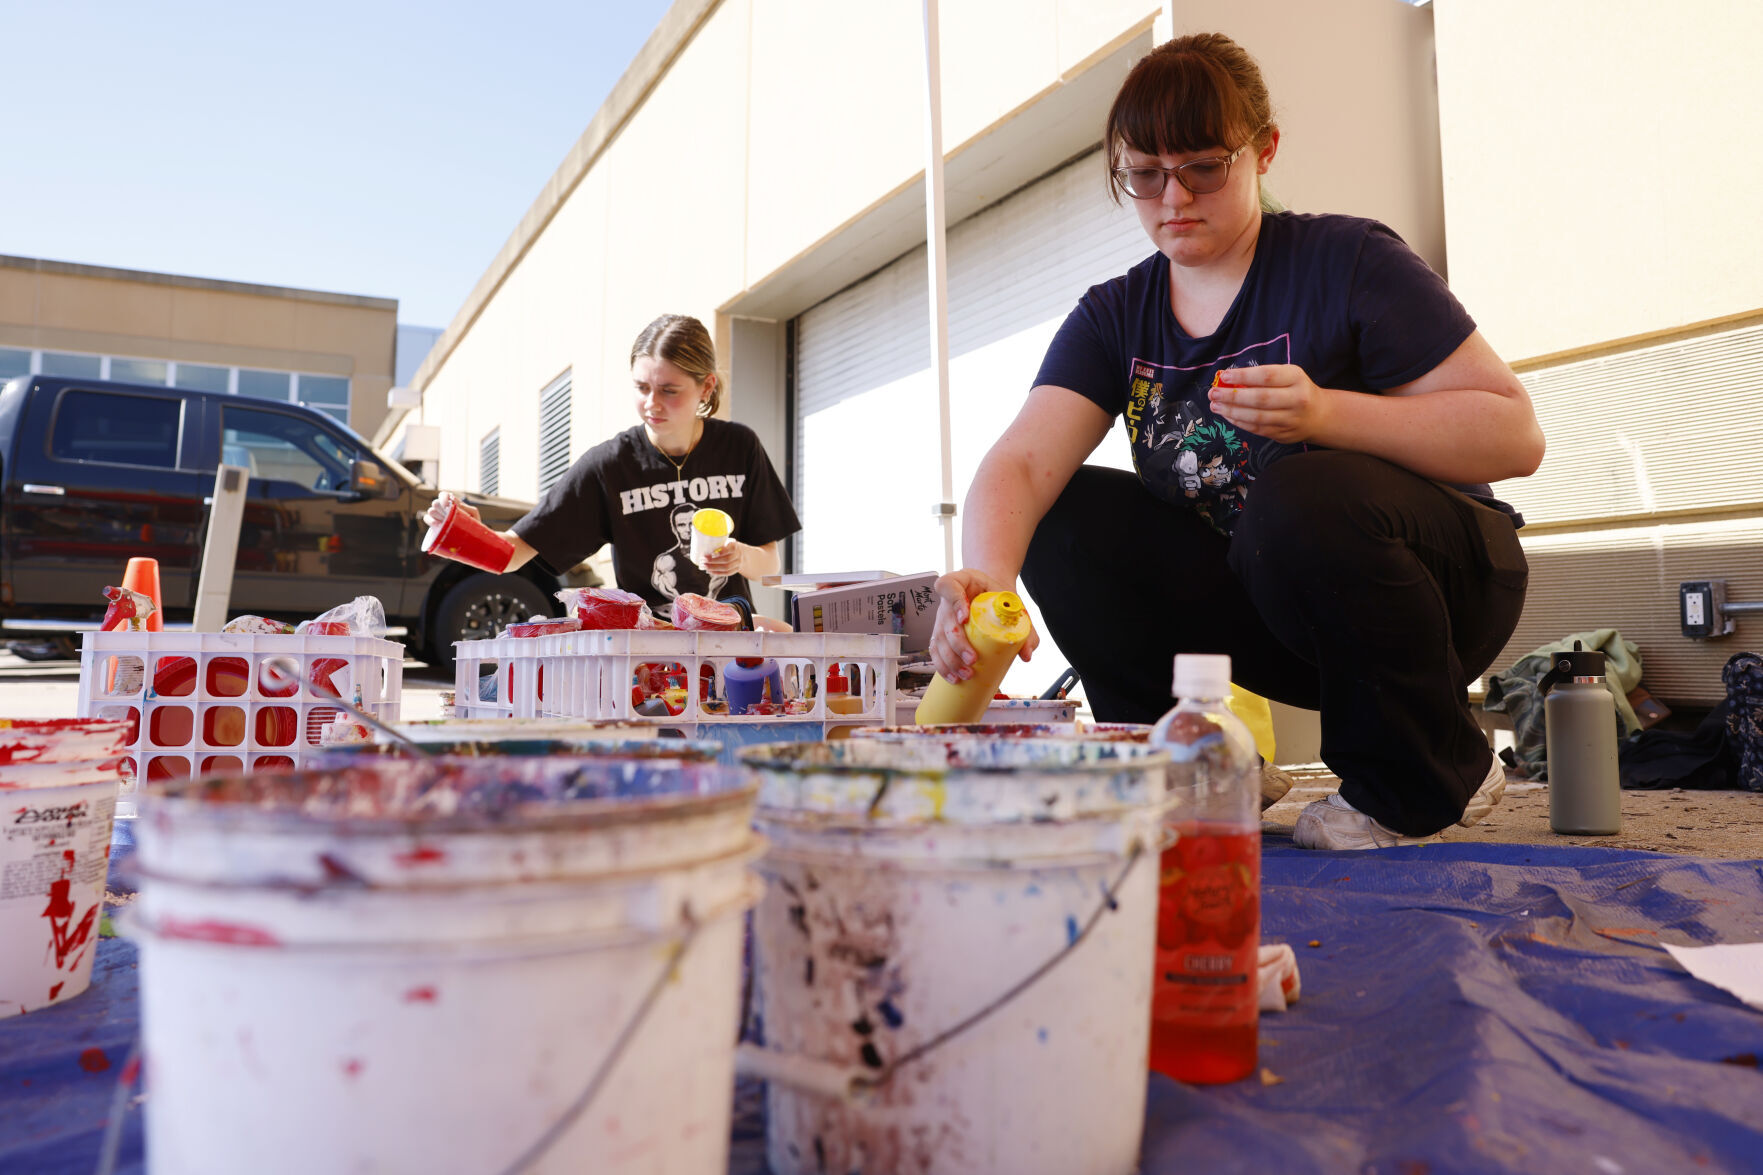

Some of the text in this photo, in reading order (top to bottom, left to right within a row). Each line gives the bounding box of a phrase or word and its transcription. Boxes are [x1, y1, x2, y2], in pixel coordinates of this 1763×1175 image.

[620, 474, 746, 516] HISTORY
[921, 585, 936, 605] Mont
[877, 594, 887, 626] Pastels
[1184, 955, 1233, 972] CHERRY
